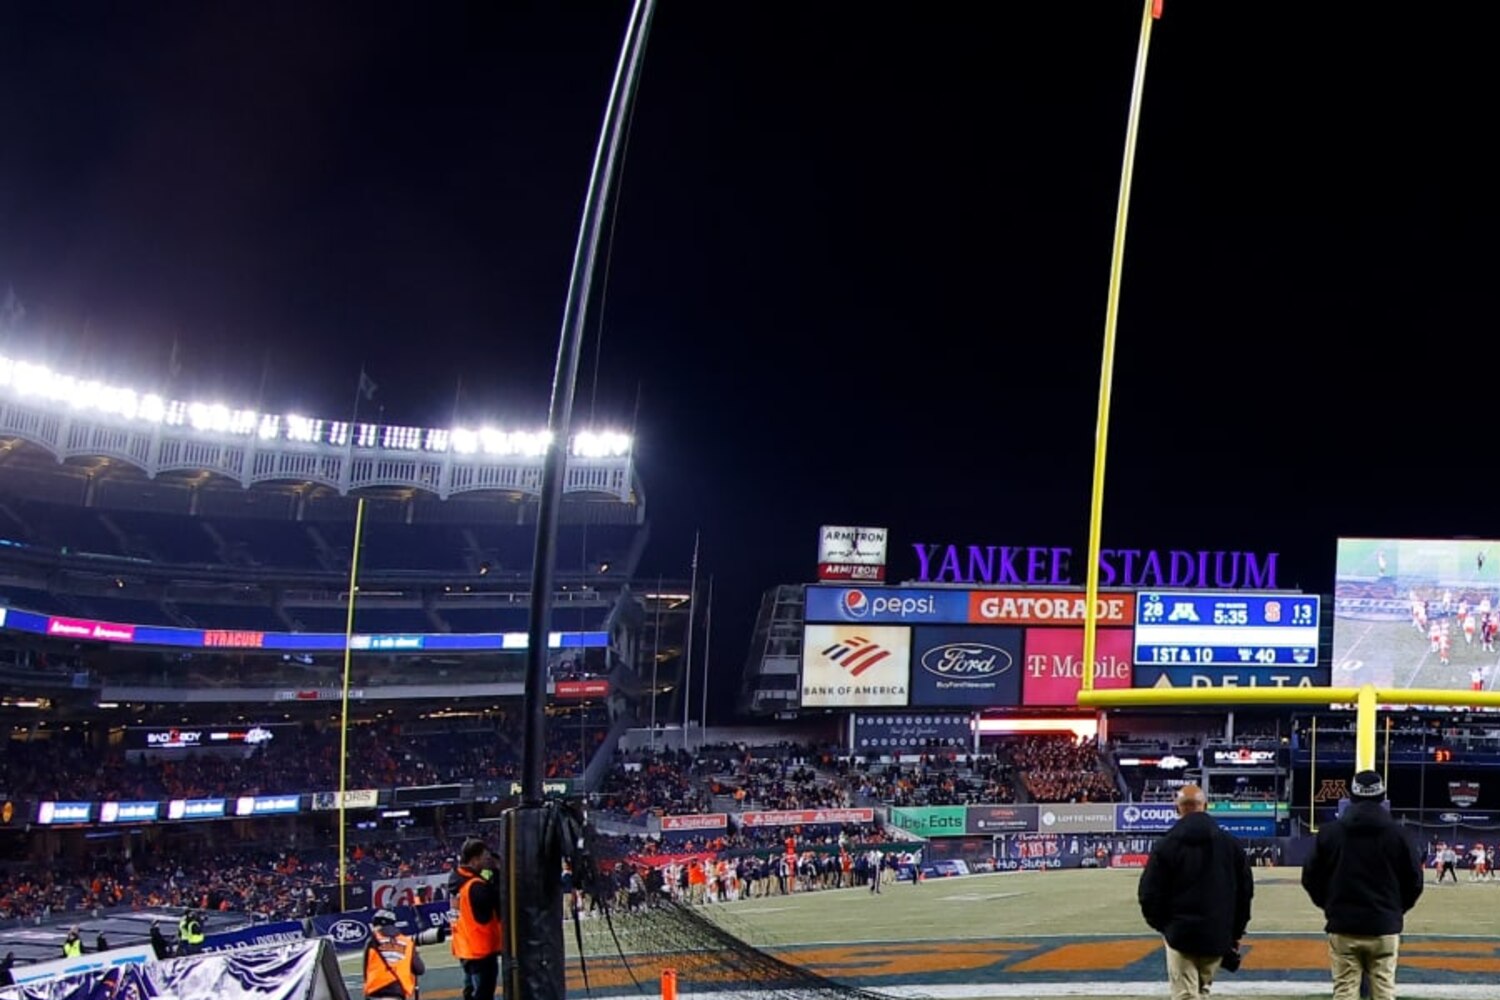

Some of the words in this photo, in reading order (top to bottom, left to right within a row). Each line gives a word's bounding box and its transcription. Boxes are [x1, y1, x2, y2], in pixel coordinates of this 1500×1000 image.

[825, 531, 884, 542] ARMITRON
[826, 565, 879, 575] ARMITRON
[912, 543, 1073, 586] YANKEE
[1097, 549, 1280, 589] STADIUM
[873, 594, 934, 618] pepsi
[980, 597, 1124, 620] GATORADE
[1143, 602, 1164, 617] 28
[1292, 604, 1312, 619] 13
[1214, 609, 1248, 624] 5:35
[204, 630, 264, 648] SYRACUSE
[937, 648, 995, 676] Ford
[1152, 647, 1178, 662] 1ST
[1195, 647, 1214, 663] 10
[1254, 649, 1276, 663] 40
[804, 686, 835, 696] BANK
[837, 686, 853, 696] OF
[854, 686, 906, 696] AMERICA
[929, 811, 962, 828] Eats
[335, 922, 363, 941] Ford
